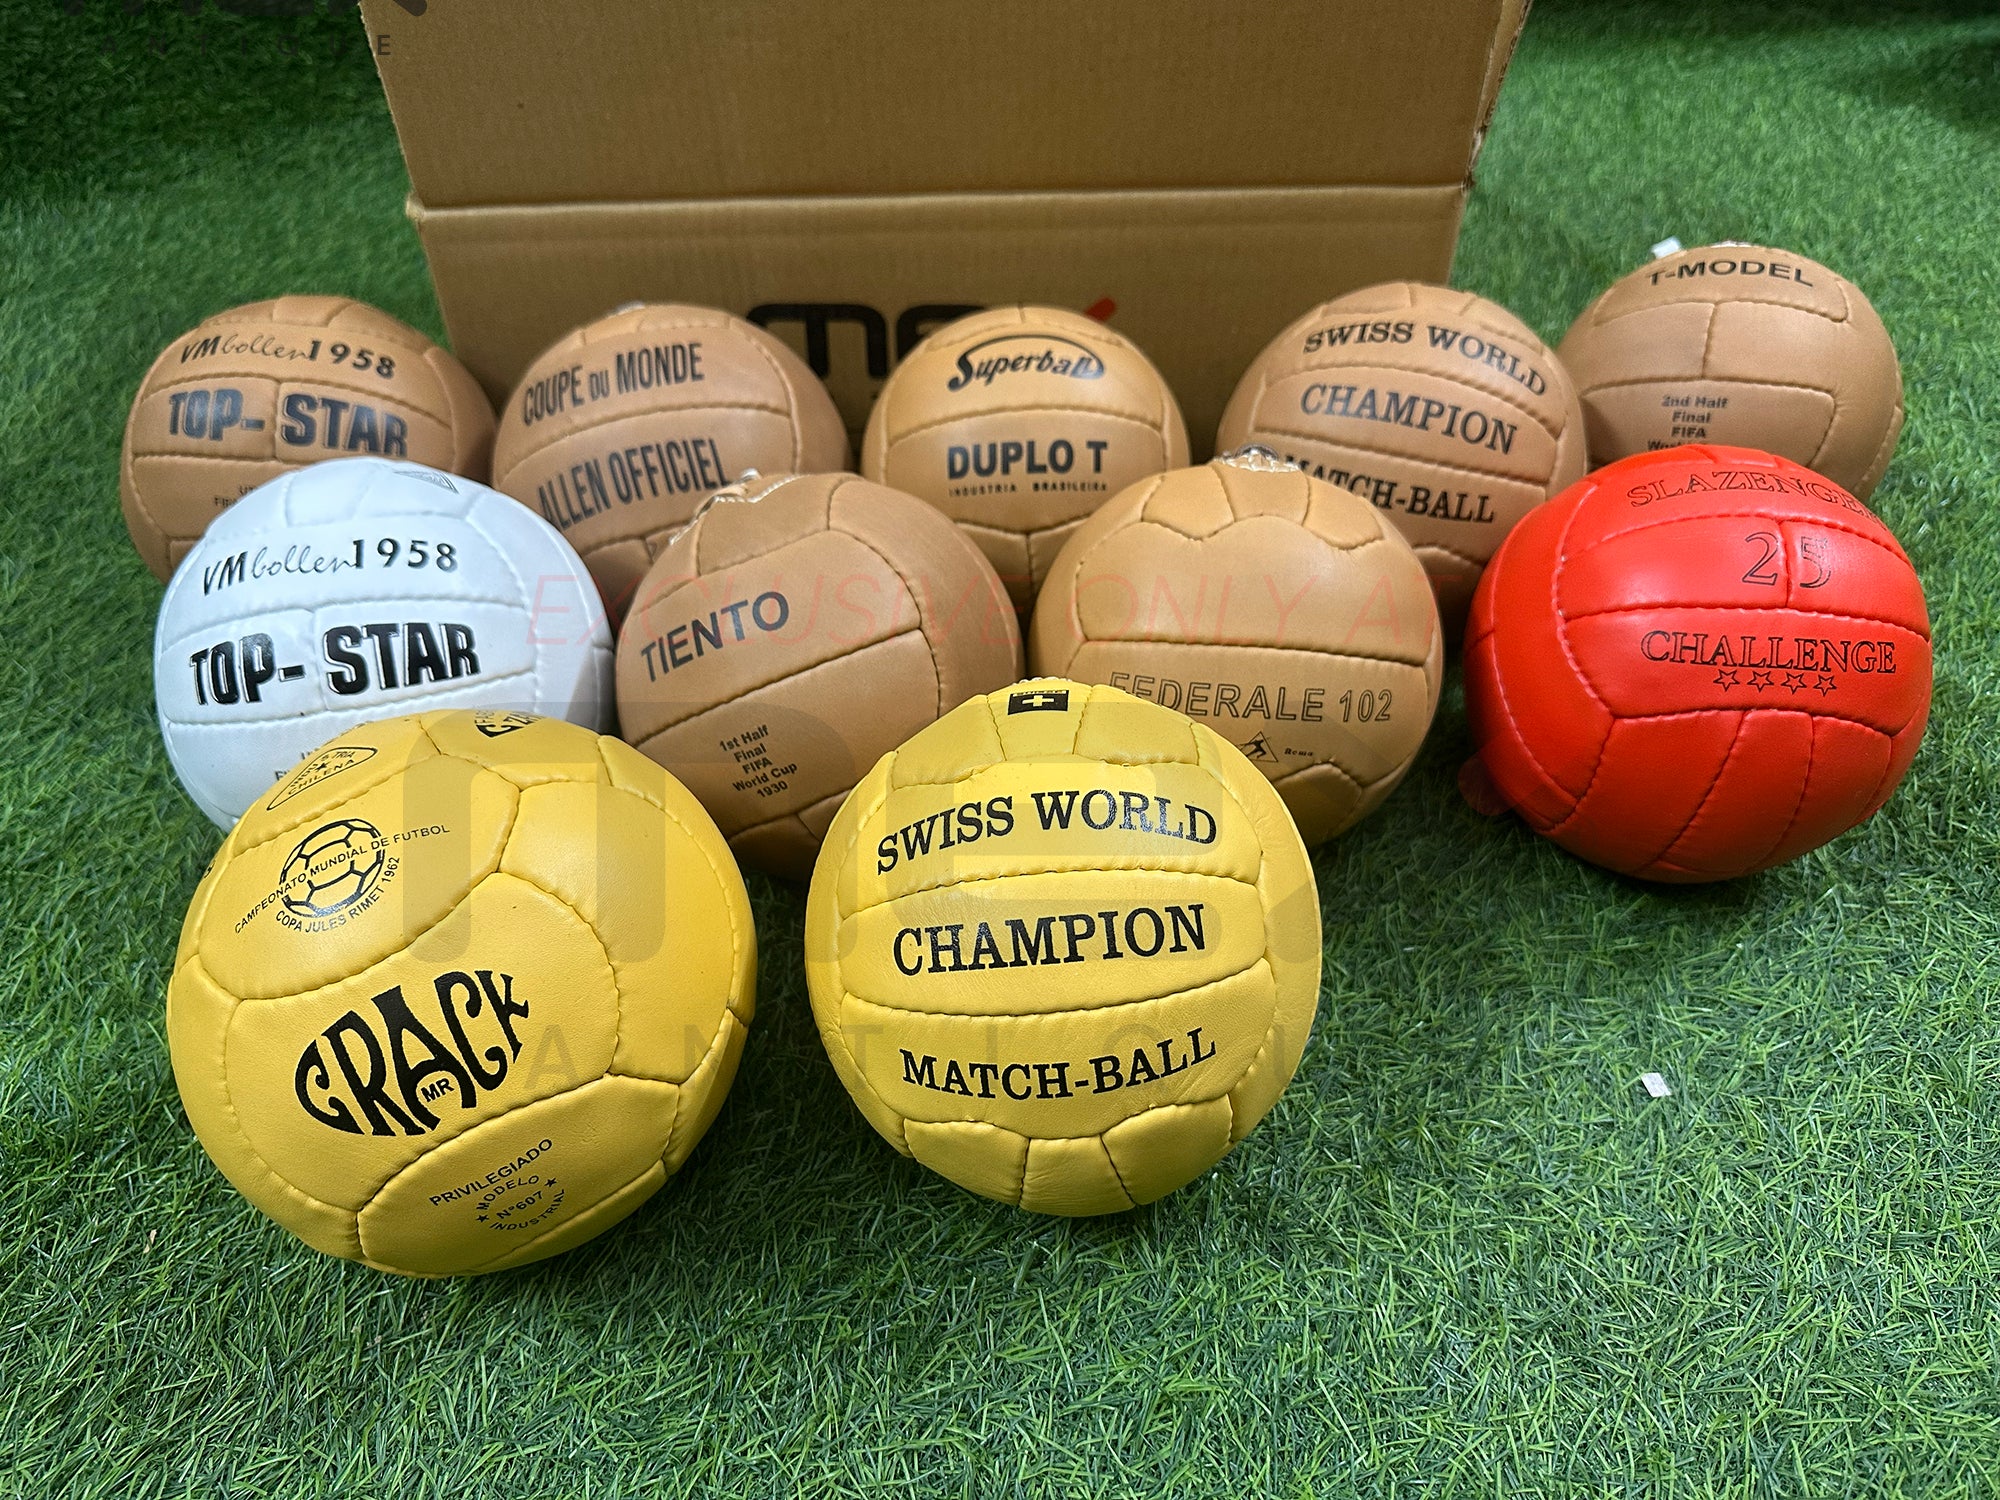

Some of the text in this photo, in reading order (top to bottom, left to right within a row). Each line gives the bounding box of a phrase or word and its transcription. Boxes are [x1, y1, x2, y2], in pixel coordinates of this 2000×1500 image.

[1645, 260, 1814, 288] T-MODEL
[307, 339, 396, 380] 1958
[947, 334, 1106, 392] Superball
[1302, 320, 1547, 397] SWISS WORLD
[521, 365, 585, 427] COUPE
[615, 341, 706, 394] MONDE
[1661, 393, 1729, 409] 2nd Half
[168, 388, 409, 458] TOP- STAR
[1299, 382, 1518, 456] CHAMPION
[1670, 425, 1707, 438] FIFA
[1671, 409, 1712, 424] Final
[946, 438, 1108, 480] DUPLO T
[536, 437, 731, 531] ALLEN OFFICIEL
[949, 482, 1017, 498] INDUSTRIA
[350, 537, 459, 573] 1958
[639, 590, 790, 683] TIENTO
[1640, 629, 1898, 675] CHALLENGE
[188, 621, 481, 706] TOP- STAR
[1109, 671, 1393, 724] FEDERALE 102
[719, 724, 769, 752] 1st Half
[733, 742, 767, 764] Final
[732, 762, 798, 792] World Cup
[742, 756, 773, 775] FIFA
[757, 780, 789, 798] 1930
[875, 788, 1218, 876] SWISS WORLD
[233, 823, 452, 934] CAMPEONATO MUNDIAL DE FUTBOL
[275, 855, 401, 933] COPA JULES RIMET 1962
[892, 902, 1208, 977] CHAMPION
[294, 969, 530, 1138] CRACK
[899, 1025, 1218, 1101] MATCH-BALL
[420, 1076, 455, 1104] MR
[428, 1138, 553, 1207] PRIVILEGIADO
[476, 1174, 540, 1211] MODELO
[489, 1188, 566, 1231] INDUSTRIAL
